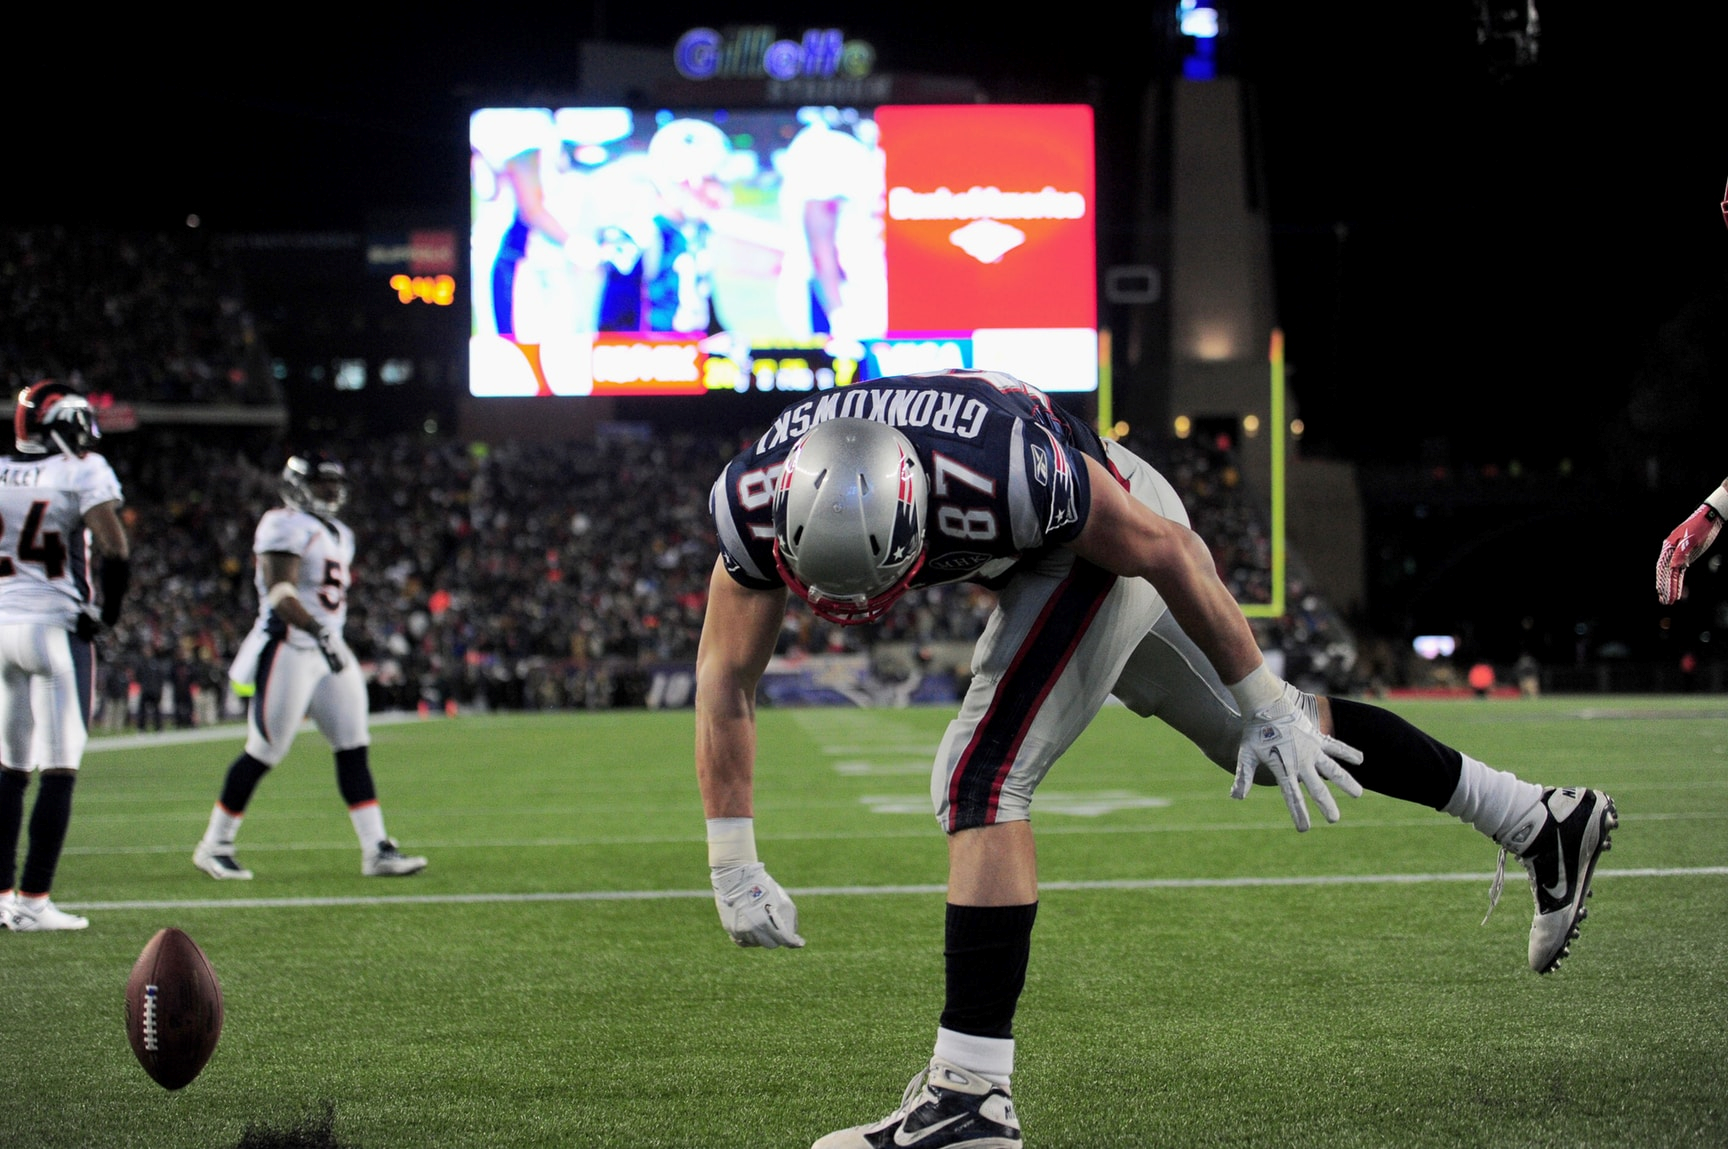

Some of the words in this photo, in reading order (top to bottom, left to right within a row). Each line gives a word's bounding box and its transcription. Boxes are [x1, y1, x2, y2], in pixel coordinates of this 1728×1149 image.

[756, 389, 989, 456] GRONKOWSKI
[932, 449, 997, 541] 87
[935, 555, 985, 568] MHK
